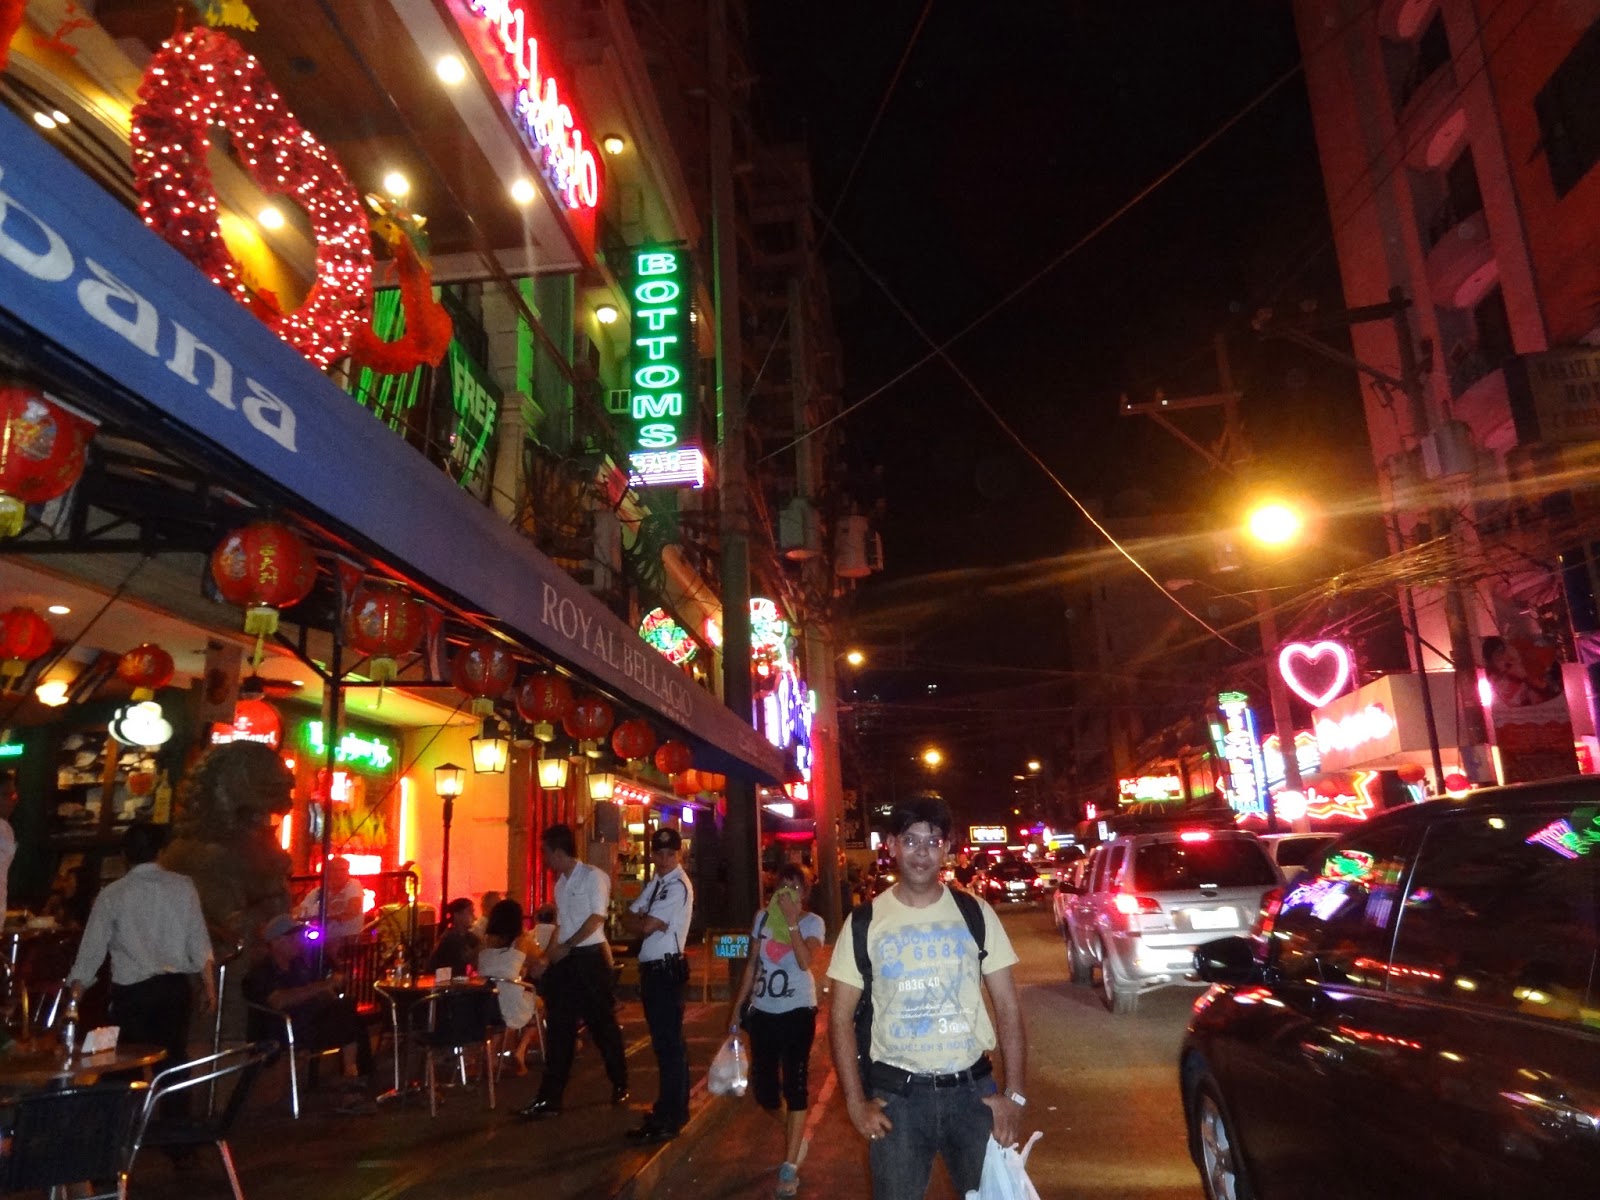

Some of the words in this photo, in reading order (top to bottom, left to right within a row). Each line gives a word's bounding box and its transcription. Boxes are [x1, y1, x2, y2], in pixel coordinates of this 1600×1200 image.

[632, 253, 682, 447] BOTTOMS
[454, 358, 496, 436] FREE
[541, 582, 619, 669] ROYAL
[623, 645, 693, 717] BELLAGIO
[720, 935, 733, 944] NO
[898, 978, 924, 992] 0836
